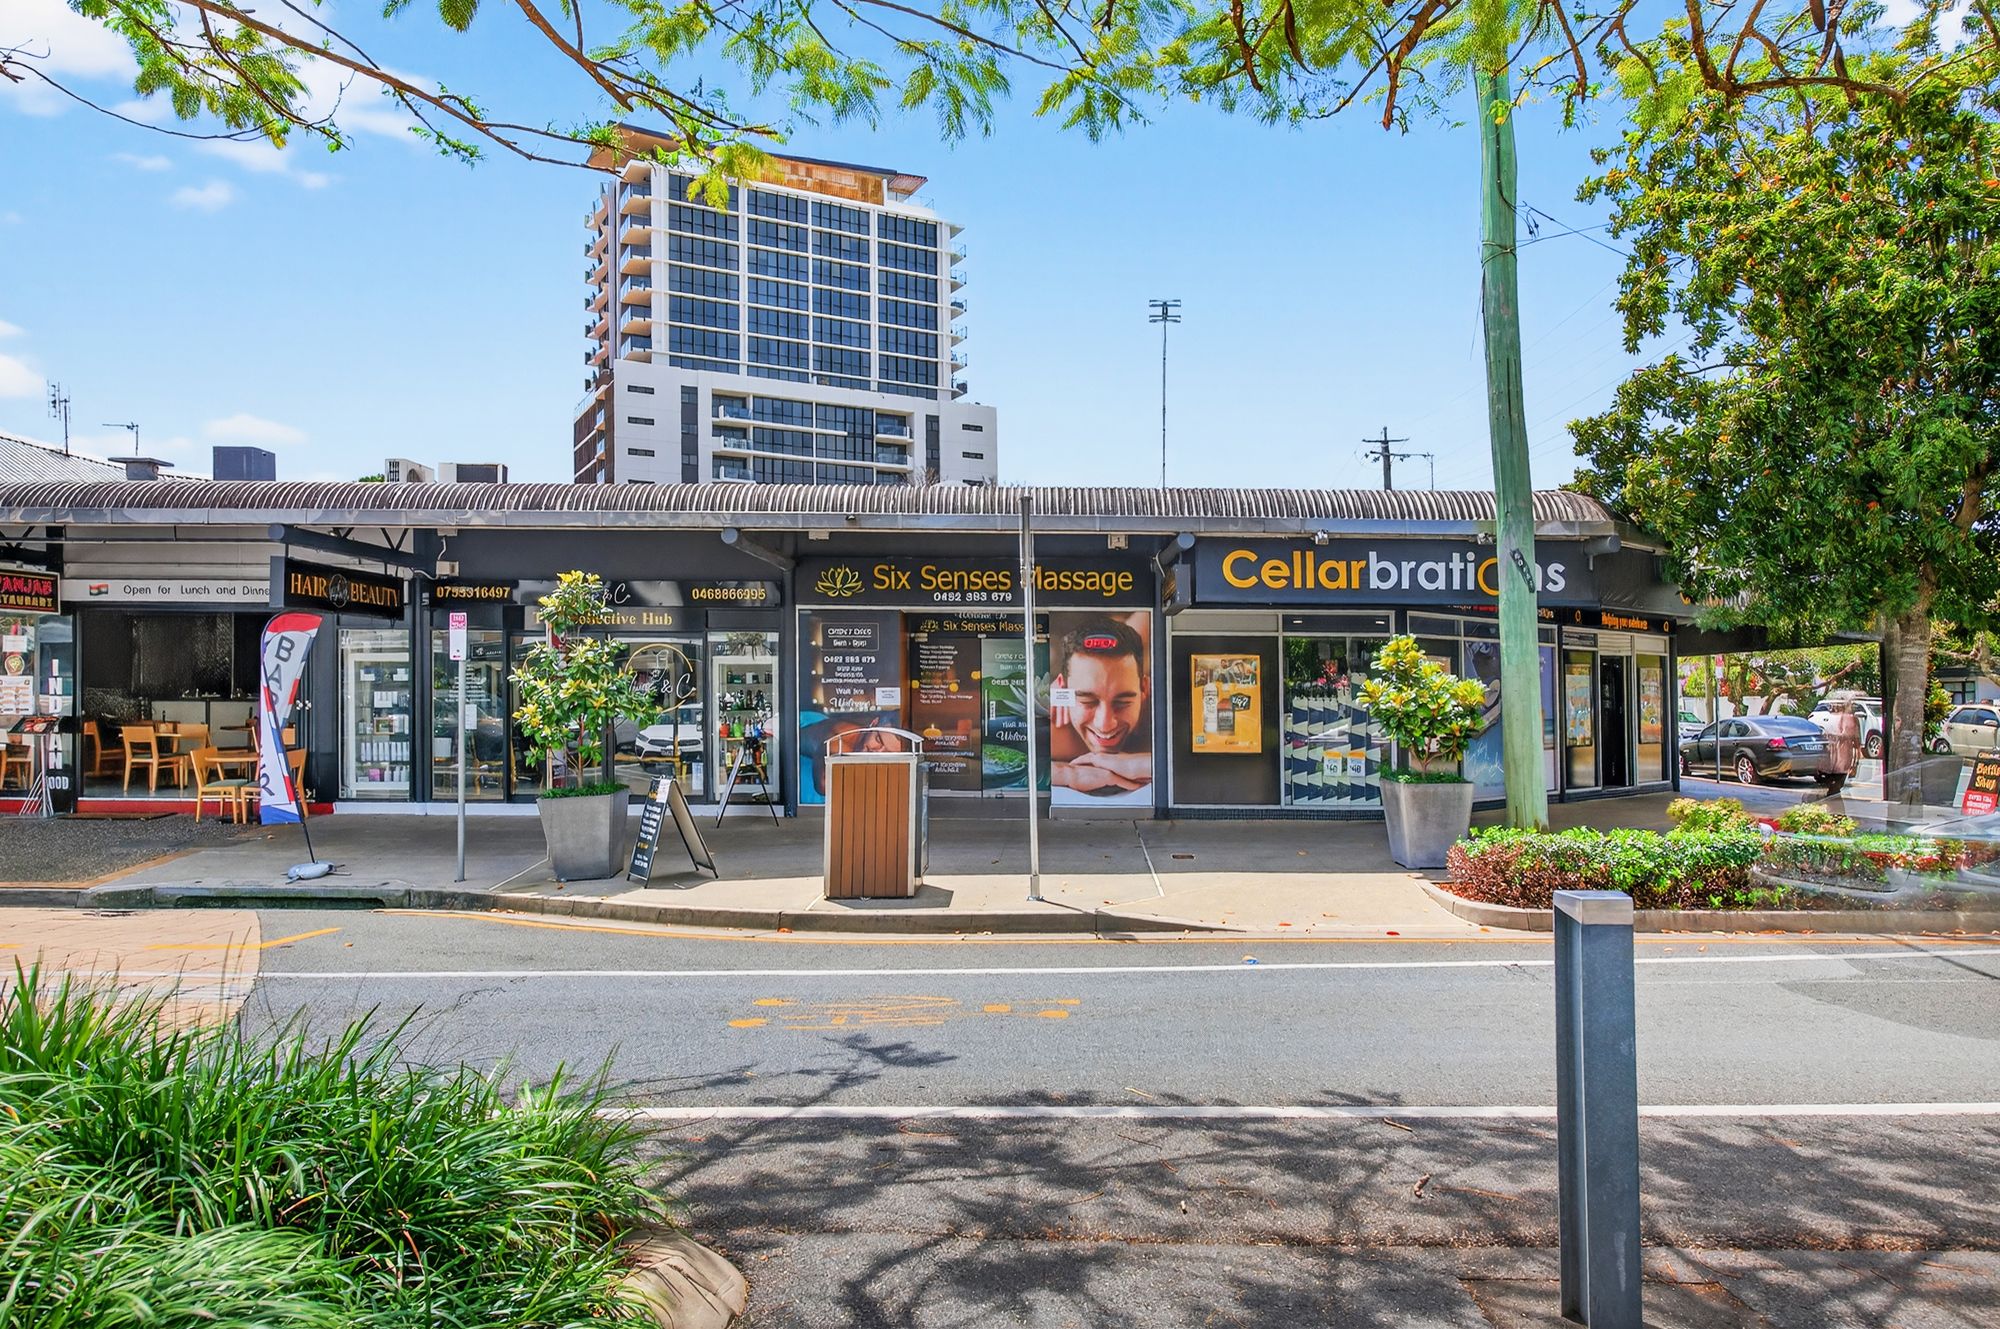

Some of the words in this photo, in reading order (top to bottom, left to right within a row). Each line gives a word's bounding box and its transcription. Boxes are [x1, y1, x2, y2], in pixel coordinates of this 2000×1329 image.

[873, 565, 911, 590] Six
[920, 565, 1012, 591] Senses
[1222, 550, 1566, 596] Cellarbratios
[0, 575, 52, 596] ANJAB
[123, 584, 151, 596] Open
[158, 585, 171, 594] for
[180, 585, 210, 595] Lunch
[216, 586, 236, 596] and
[242, 586, 270, 596] Dinne
[291, 573, 328, 599] HAIR
[350, 582, 400, 608] BEAUTY
[642, 612, 672, 626] Hub
[943, 620, 957, 631] Six
[960, 620, 996, 632] Senses
[999, 621, 1043, 632] Masse
[49, 659, 63, 770] INDAN
[47, 776, 69, 790] OOD
